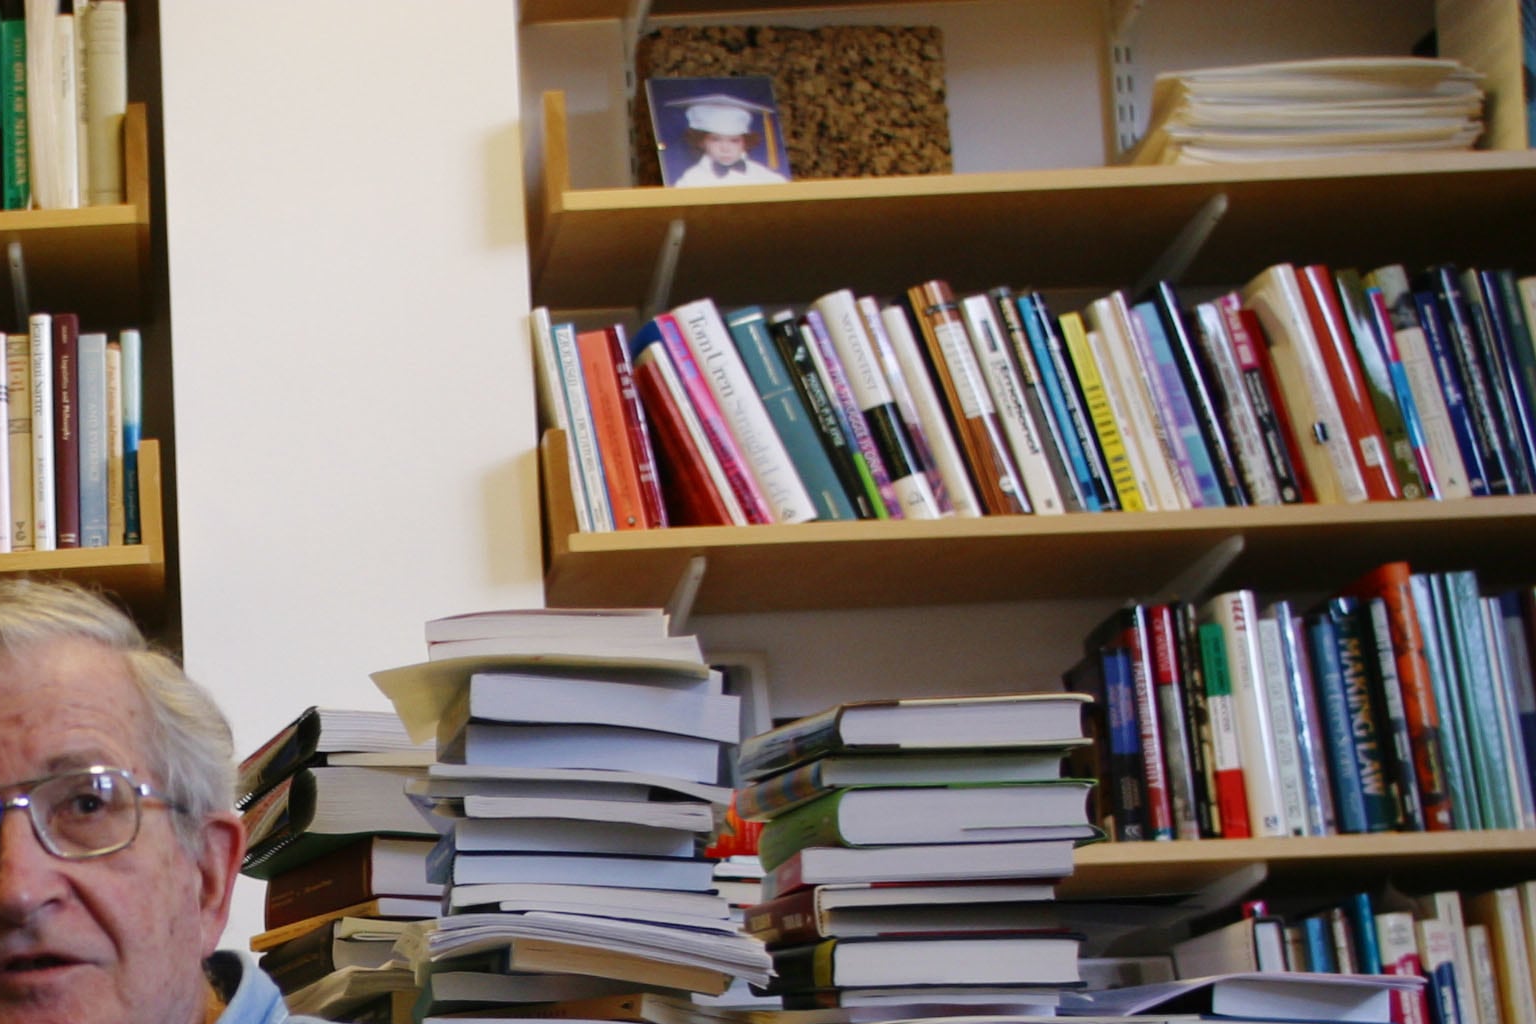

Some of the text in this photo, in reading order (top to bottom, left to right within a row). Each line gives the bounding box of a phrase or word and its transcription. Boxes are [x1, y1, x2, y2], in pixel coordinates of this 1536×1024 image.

[31, 321, 45, 417] Jean-Paul Sartre
[690, 313, 710, 350] Tom
[707, 351, 739, 398] Uren
[726, 400, 776, 466] Straight
[840, 313, 878, 391] NO CONTEST
[1131, 663, 1162, 790] PALESTINIAN IDENTITY
[1338, 639, 1384, 796] MAKING LAW
